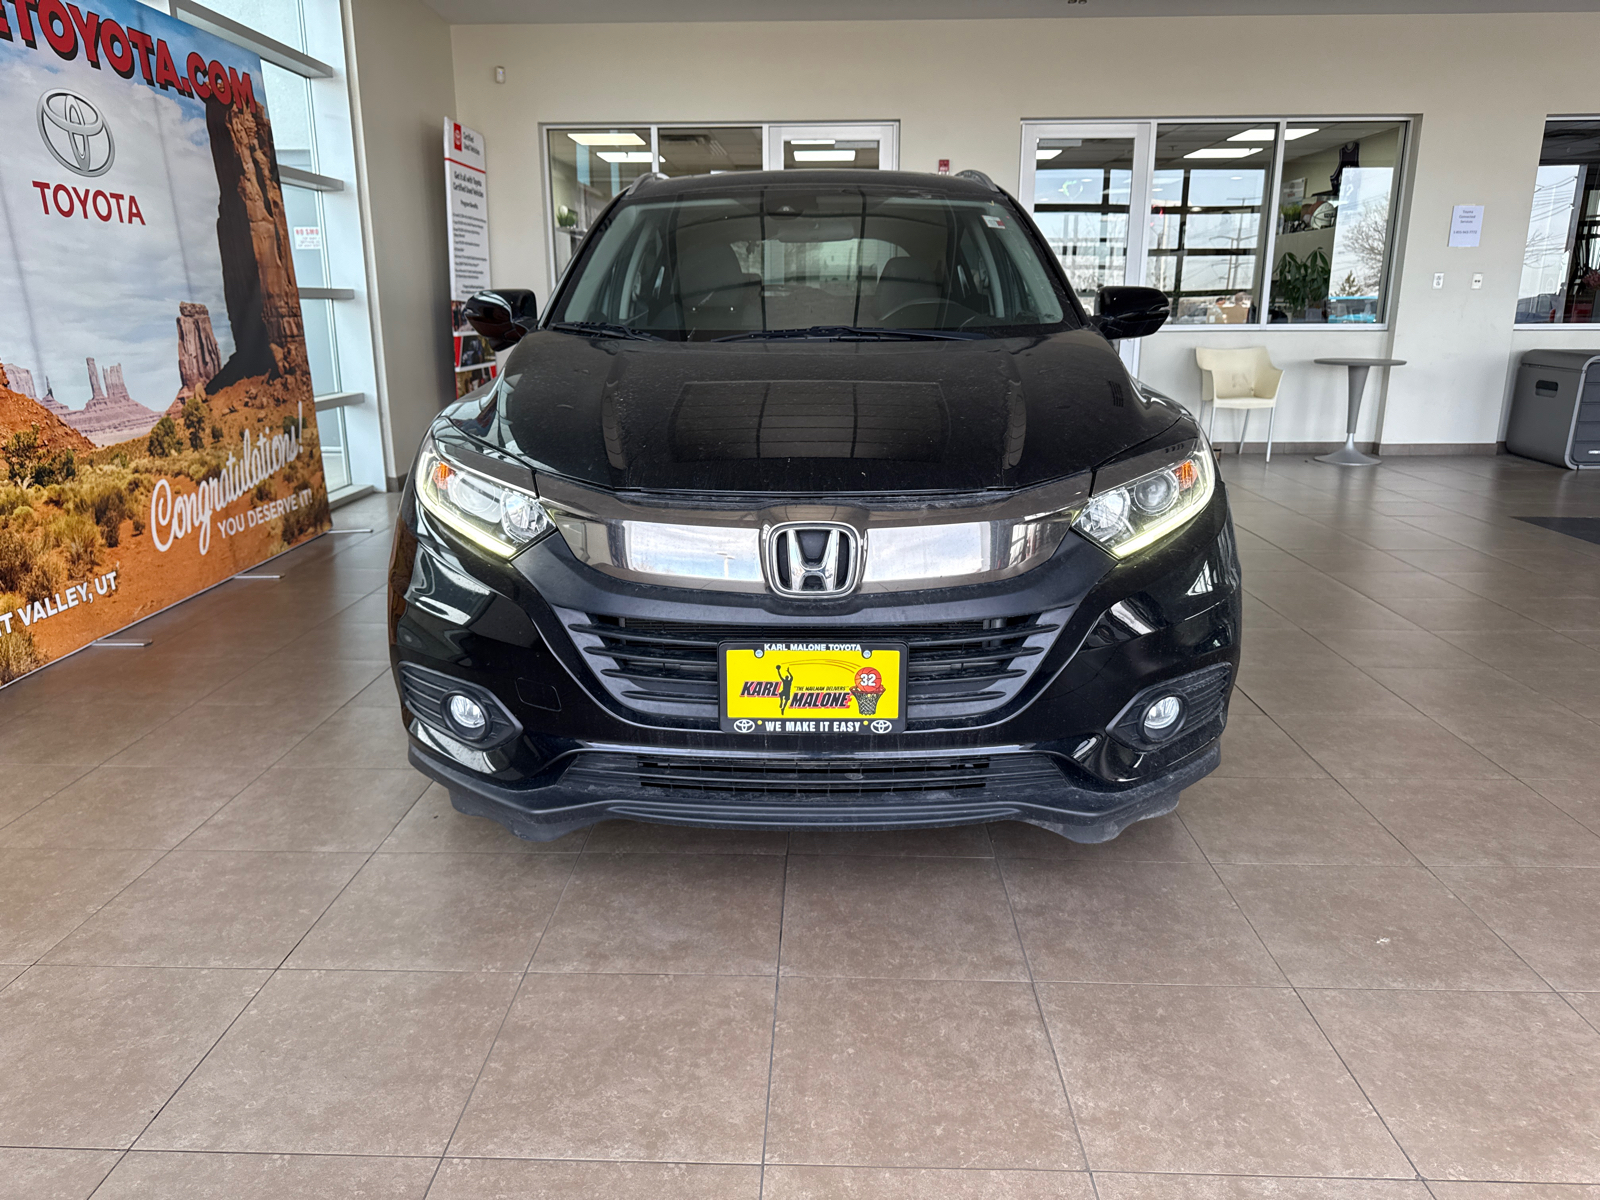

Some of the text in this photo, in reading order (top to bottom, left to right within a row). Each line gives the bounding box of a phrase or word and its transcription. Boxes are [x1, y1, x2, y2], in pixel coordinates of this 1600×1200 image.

[32, 180, 147, 226] TOYOTA
[151, 400, 303, 556] Congratulations!
[217, 488, 313, 539] YOU DESERVE IT!
[16, 581, 94, 627] VALLEY,
[94, 570, 117, 596] UT
[764, 643, 862, 651] KARL MALONE TOYOTA
[859, 673, 876, 687] 32
[740, 681, 782, 698] KARL
[789, 692, 853, 709] MALONE
[765, 721, 861, 732] WE MAKE IT EASY
